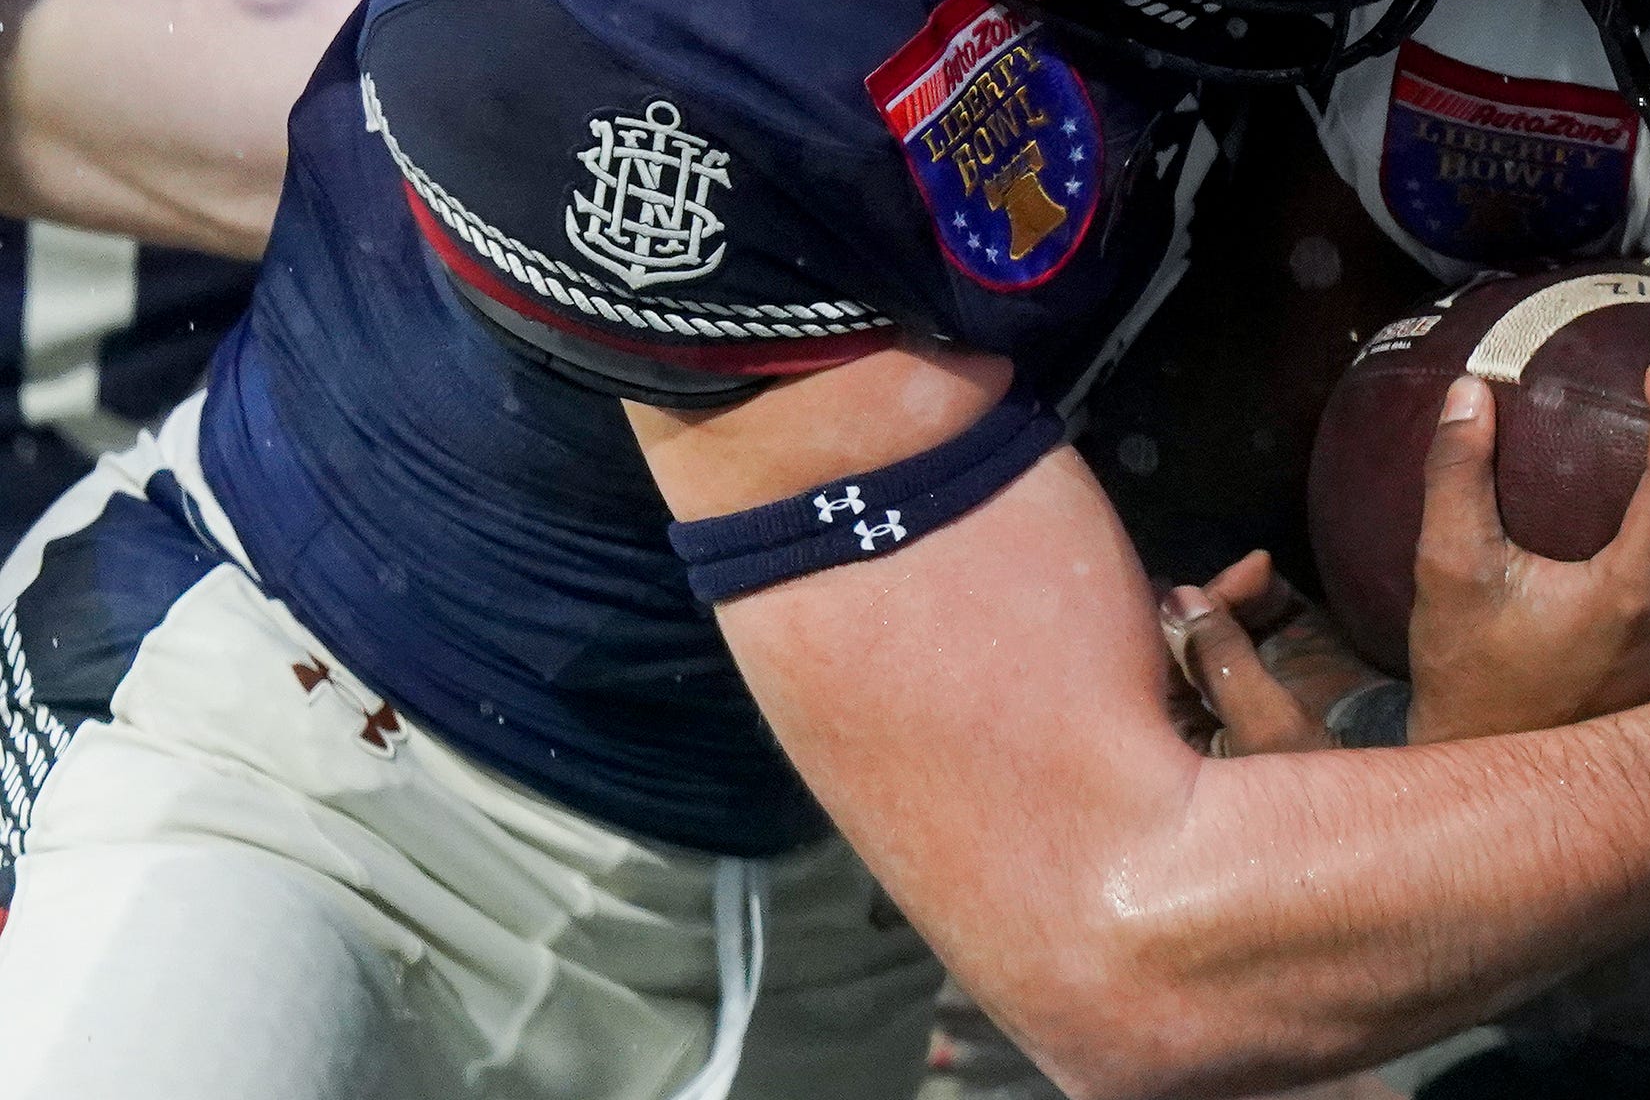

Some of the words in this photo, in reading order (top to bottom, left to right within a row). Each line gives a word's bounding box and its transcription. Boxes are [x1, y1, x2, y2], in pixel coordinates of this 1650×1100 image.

[941, 6, 1034, 92] AutoZon
[919, 41, 1042, 164] LIBERTY
[1468, 102, 1622, 146] AutoZone
[951, 84, 1048, 198] BOWL
[1411, 116, 1602, 170] LIBERTY
[1436, 151, 1573, 195] BOWL
